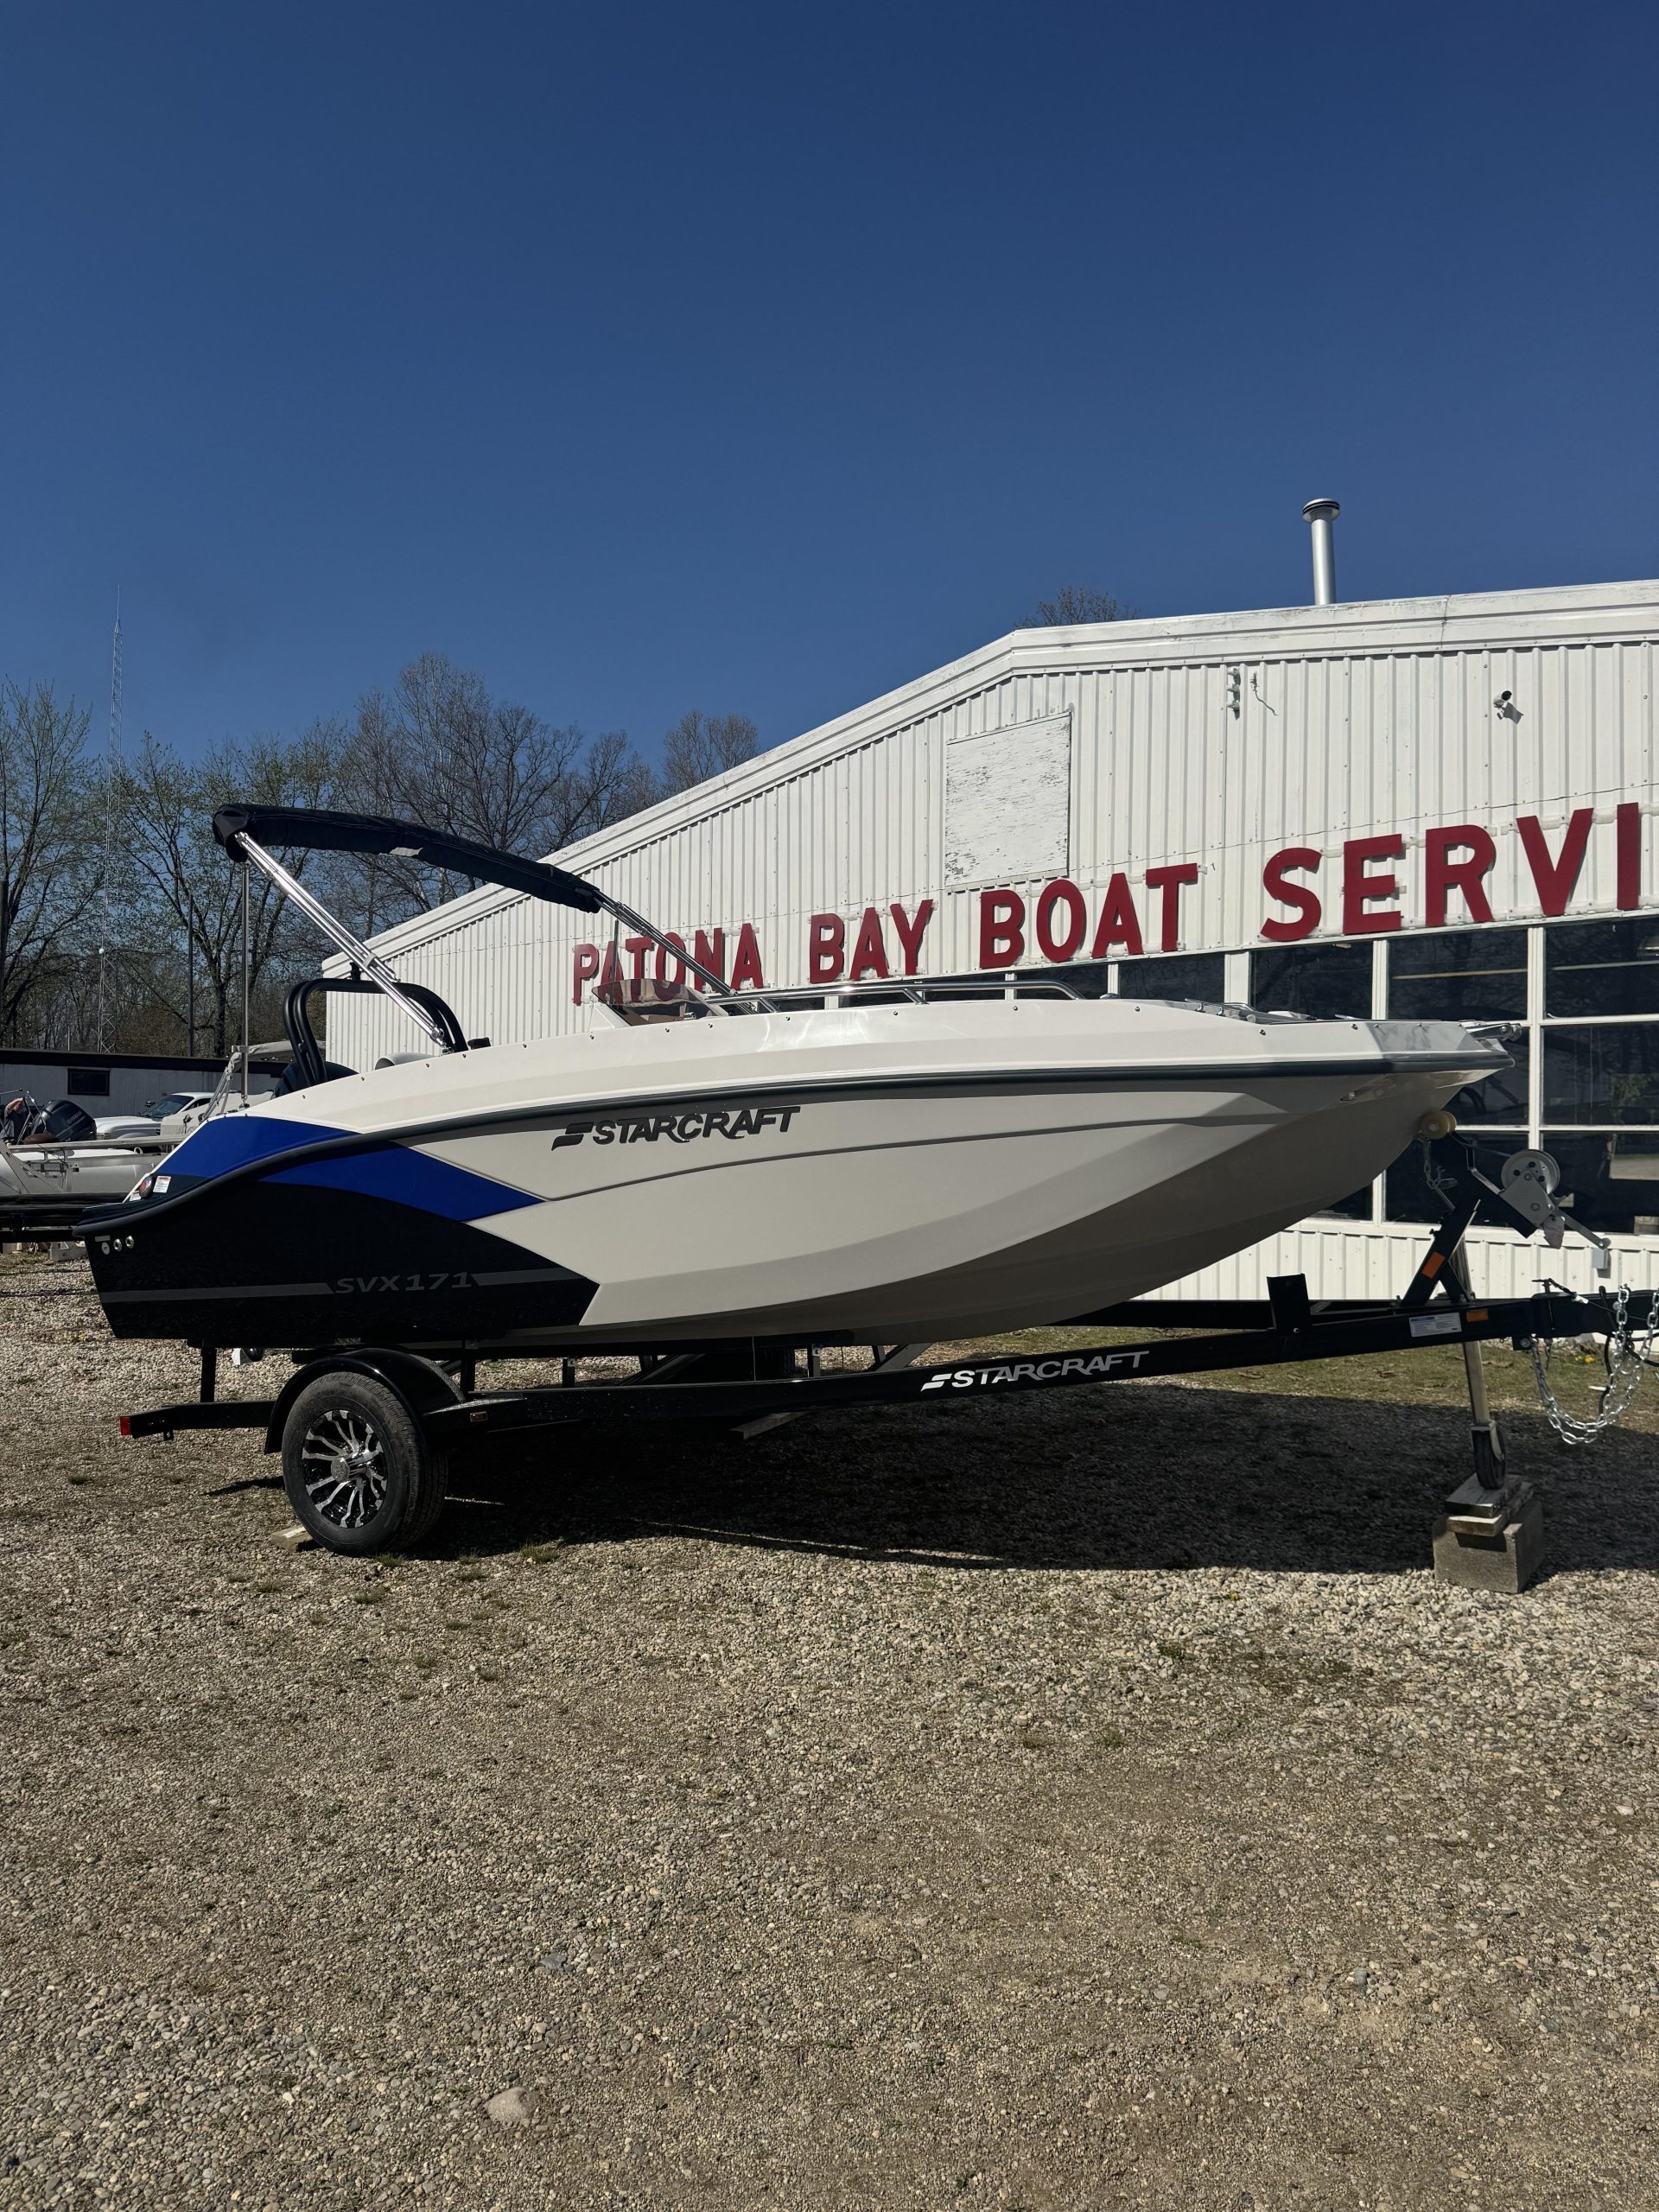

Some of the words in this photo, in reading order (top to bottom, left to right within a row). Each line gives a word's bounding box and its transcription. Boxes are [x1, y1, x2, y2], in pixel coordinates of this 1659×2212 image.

[573, 923, 763, 1005] PATONA
[810, 899, 933, 983] BAY
[980, 863, 1198, 969] BOAT
[1261, 802, 1639, 942] SERVI
[592, 1106, 801, 1145] STARCRAFT
[951, 1351, 1150, 1388] STARCRAFT
